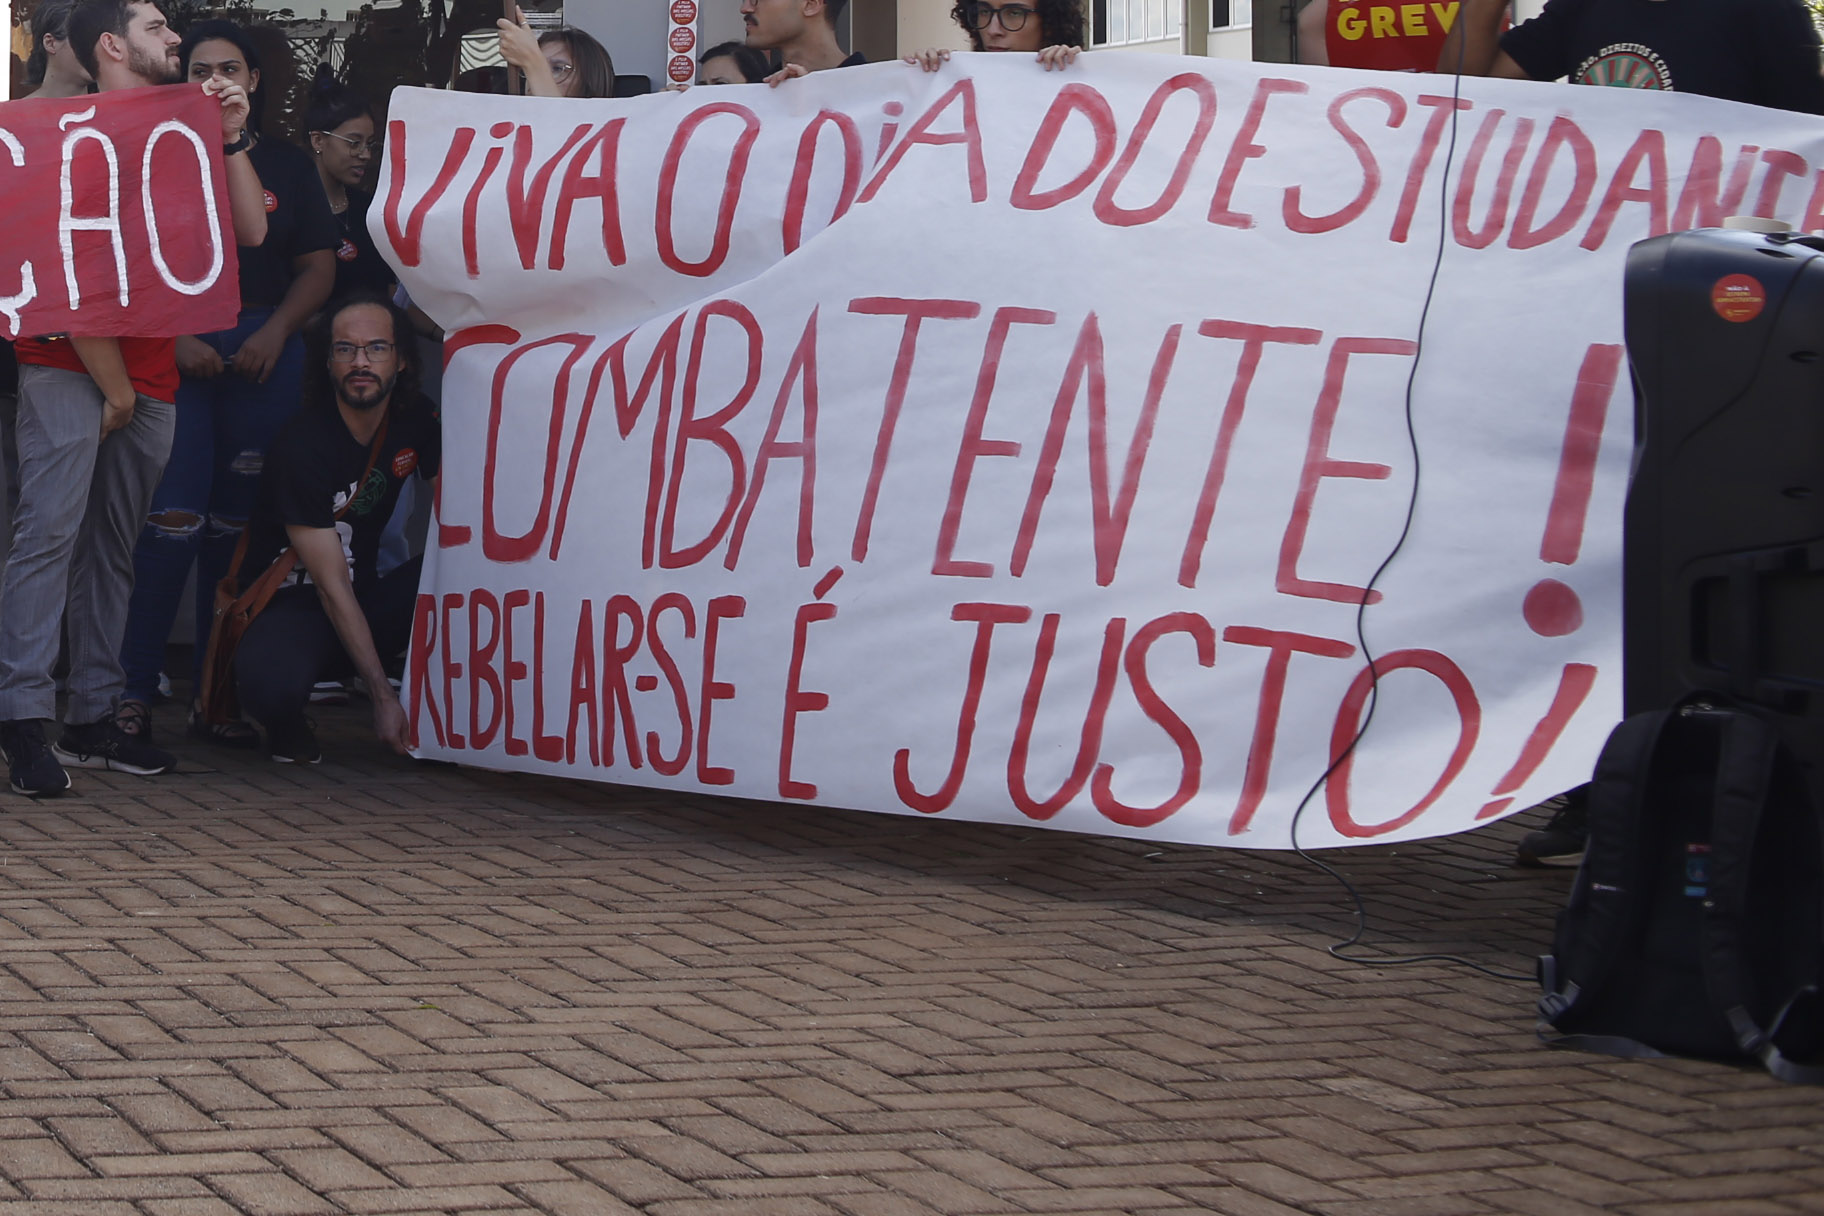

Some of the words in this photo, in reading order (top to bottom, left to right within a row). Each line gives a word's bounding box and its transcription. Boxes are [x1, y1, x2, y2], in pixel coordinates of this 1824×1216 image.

[1337, 1, 1461, 41] GREV
[1599, 42, 1652, 57] DIREITOS
[655, 101, 761, 277] O
[432, 298, 1419, 606] COMBATENTE
[777, 566, 844, 800] É
